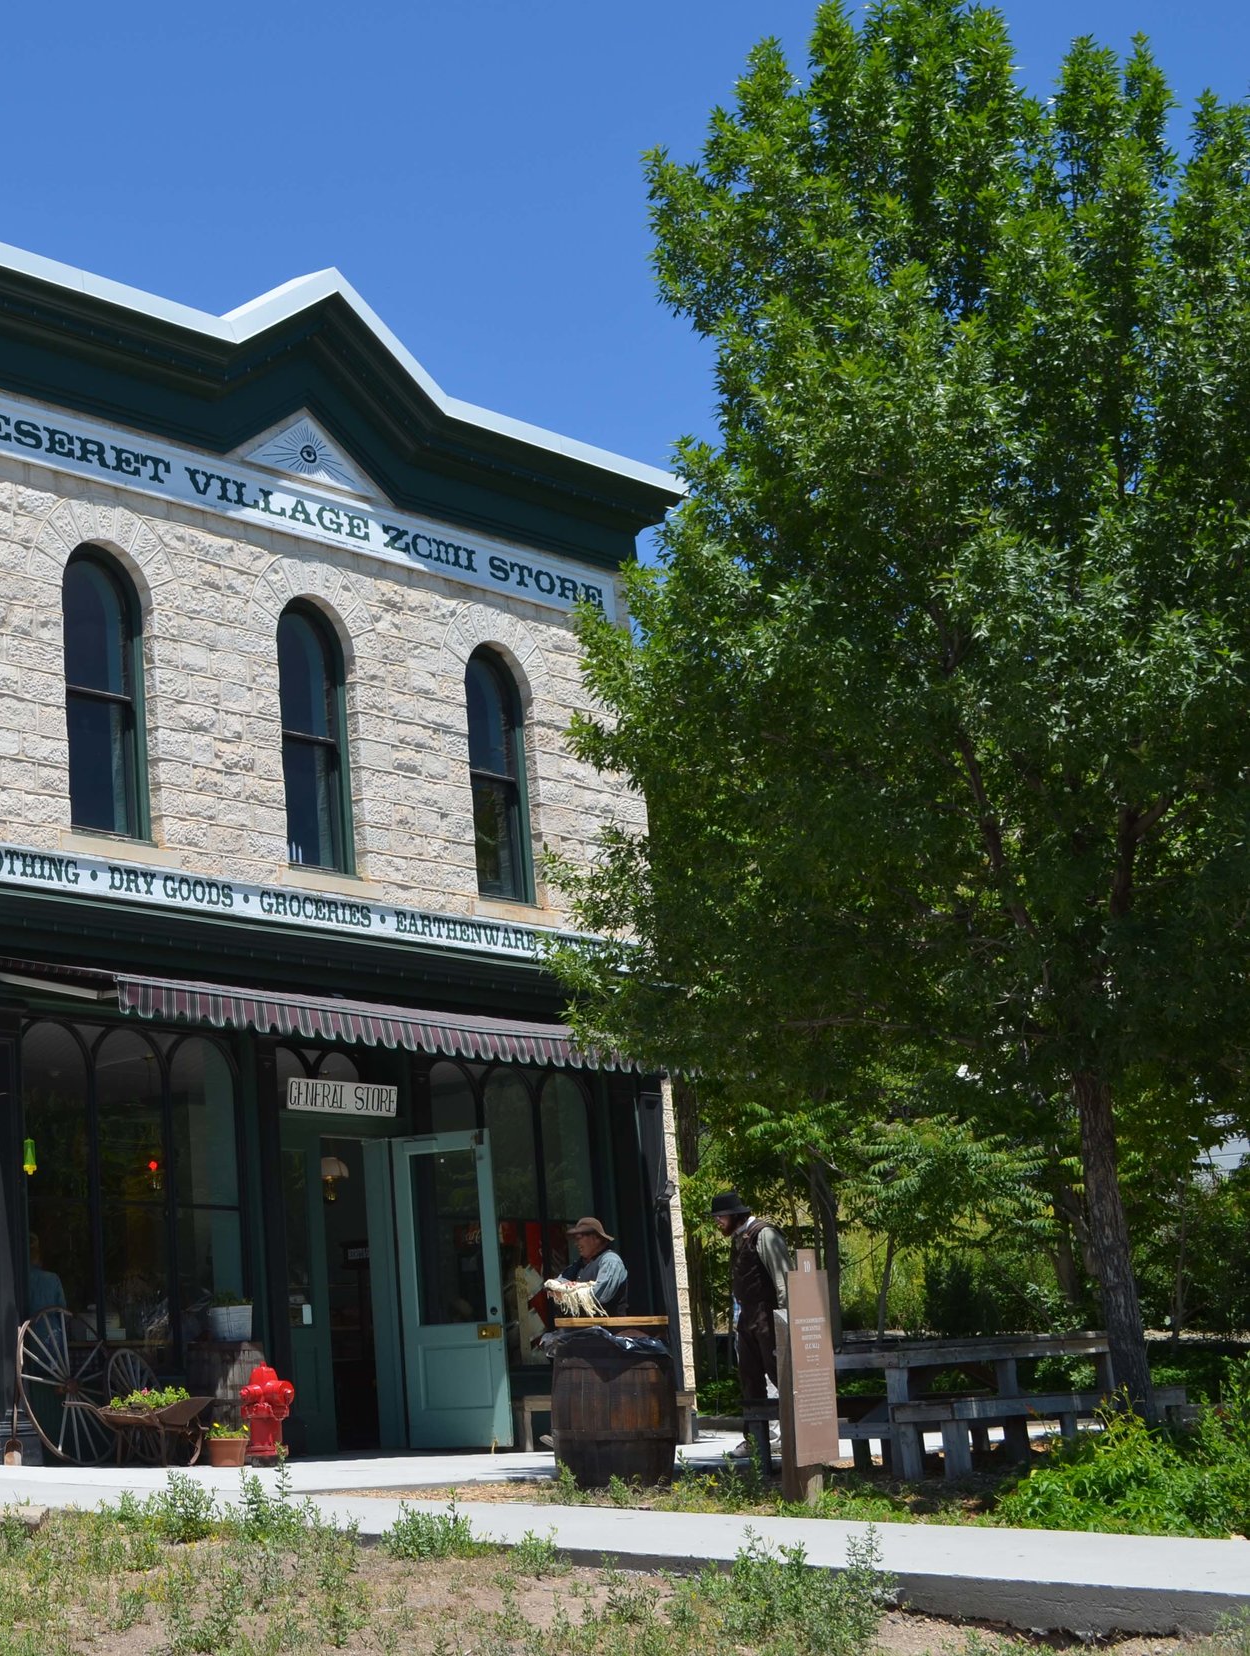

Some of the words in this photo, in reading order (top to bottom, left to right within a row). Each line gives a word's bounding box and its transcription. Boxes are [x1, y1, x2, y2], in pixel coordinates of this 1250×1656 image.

[184, 466, 371, 543] VILLAGE
[382, 523, 478, 573] ZCMI
[488, 555, 604, 612] STORE
[108, 865, 155, 896] DRY
[163, 875, 234, 908] GOODS
[259, 890, 372, 929] GROCERIES
[394, 909, 537, 952] EARTHENWARE
[289, 1080, 347, 1110] GENERAL
[354, 1086, 397, 1113] STORE
[803, 1260, 811, 1273] 10
